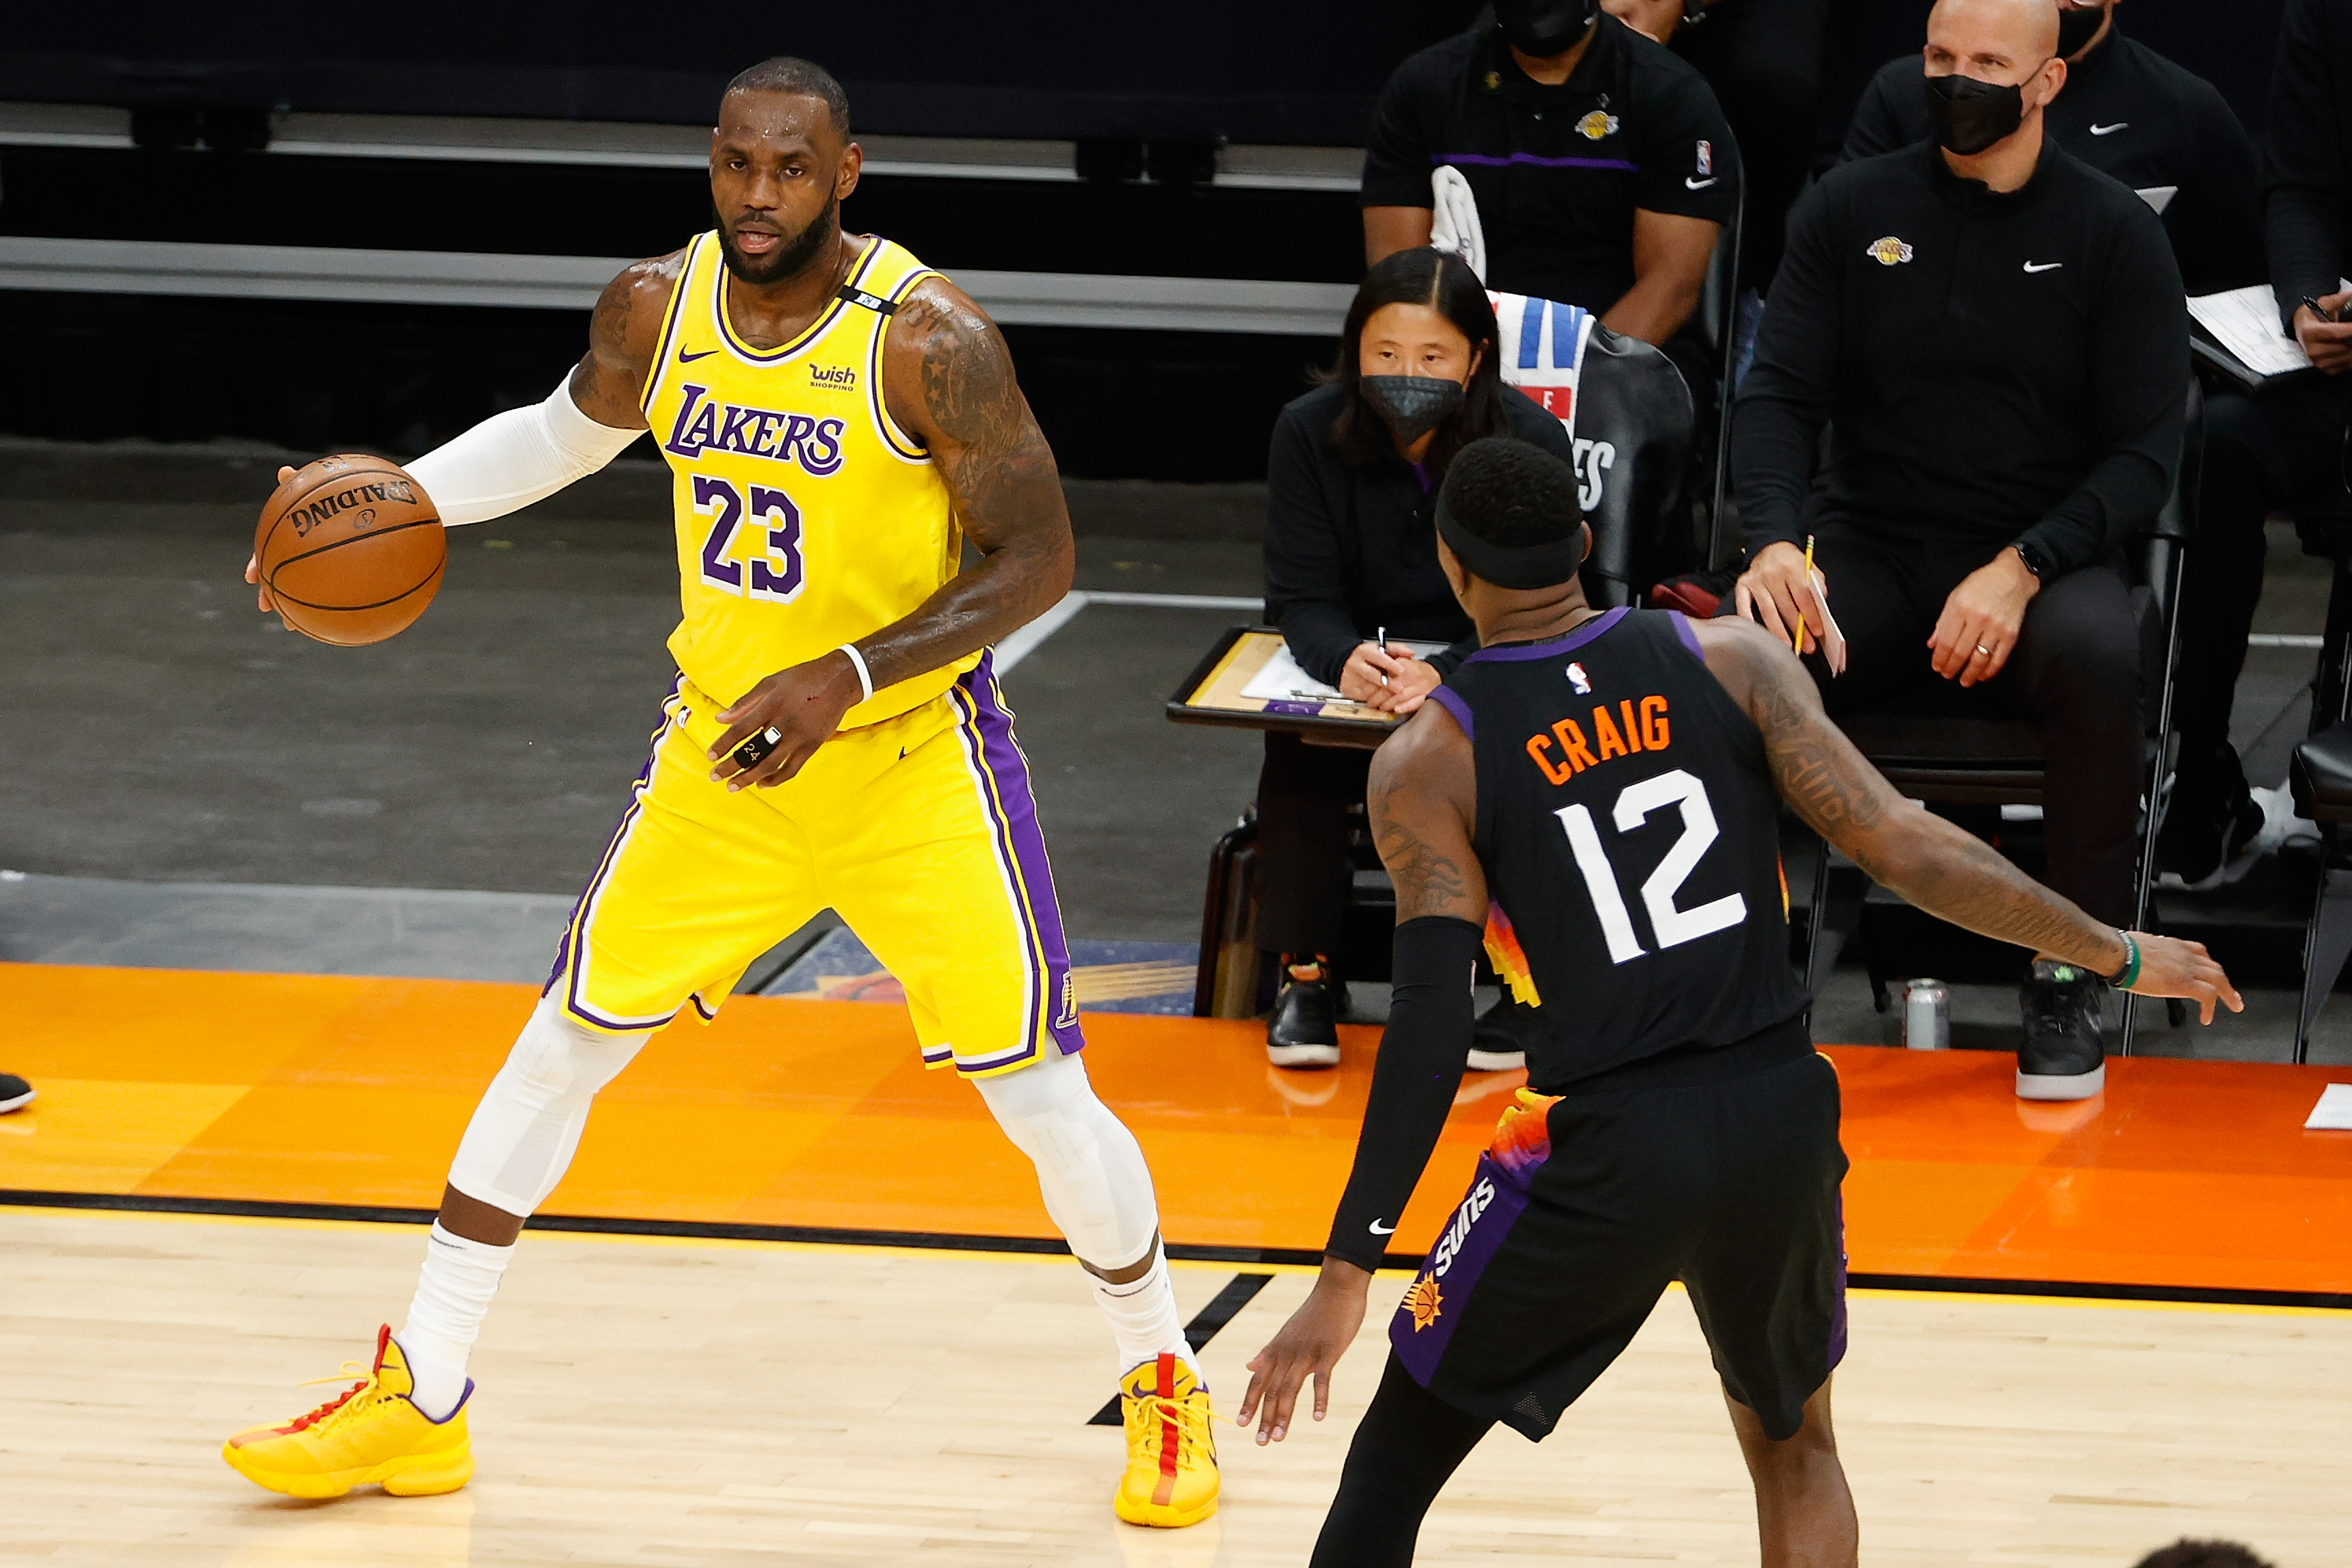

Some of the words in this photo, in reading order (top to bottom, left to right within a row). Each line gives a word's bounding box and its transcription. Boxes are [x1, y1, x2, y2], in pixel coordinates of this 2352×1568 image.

[809, 363, 856, 384] wish
[810, 382, 854, 392] SHOPPING
[665, 382, 847, 477] LAKERS
[289, 480, 417, 537] SPALDING
[691, 473, 804, 603] 23
[743, 743, 761, 762] 24
[1525, 695, 1671, 786] CRAIG
[1552, 769, 1748, 966] 12
